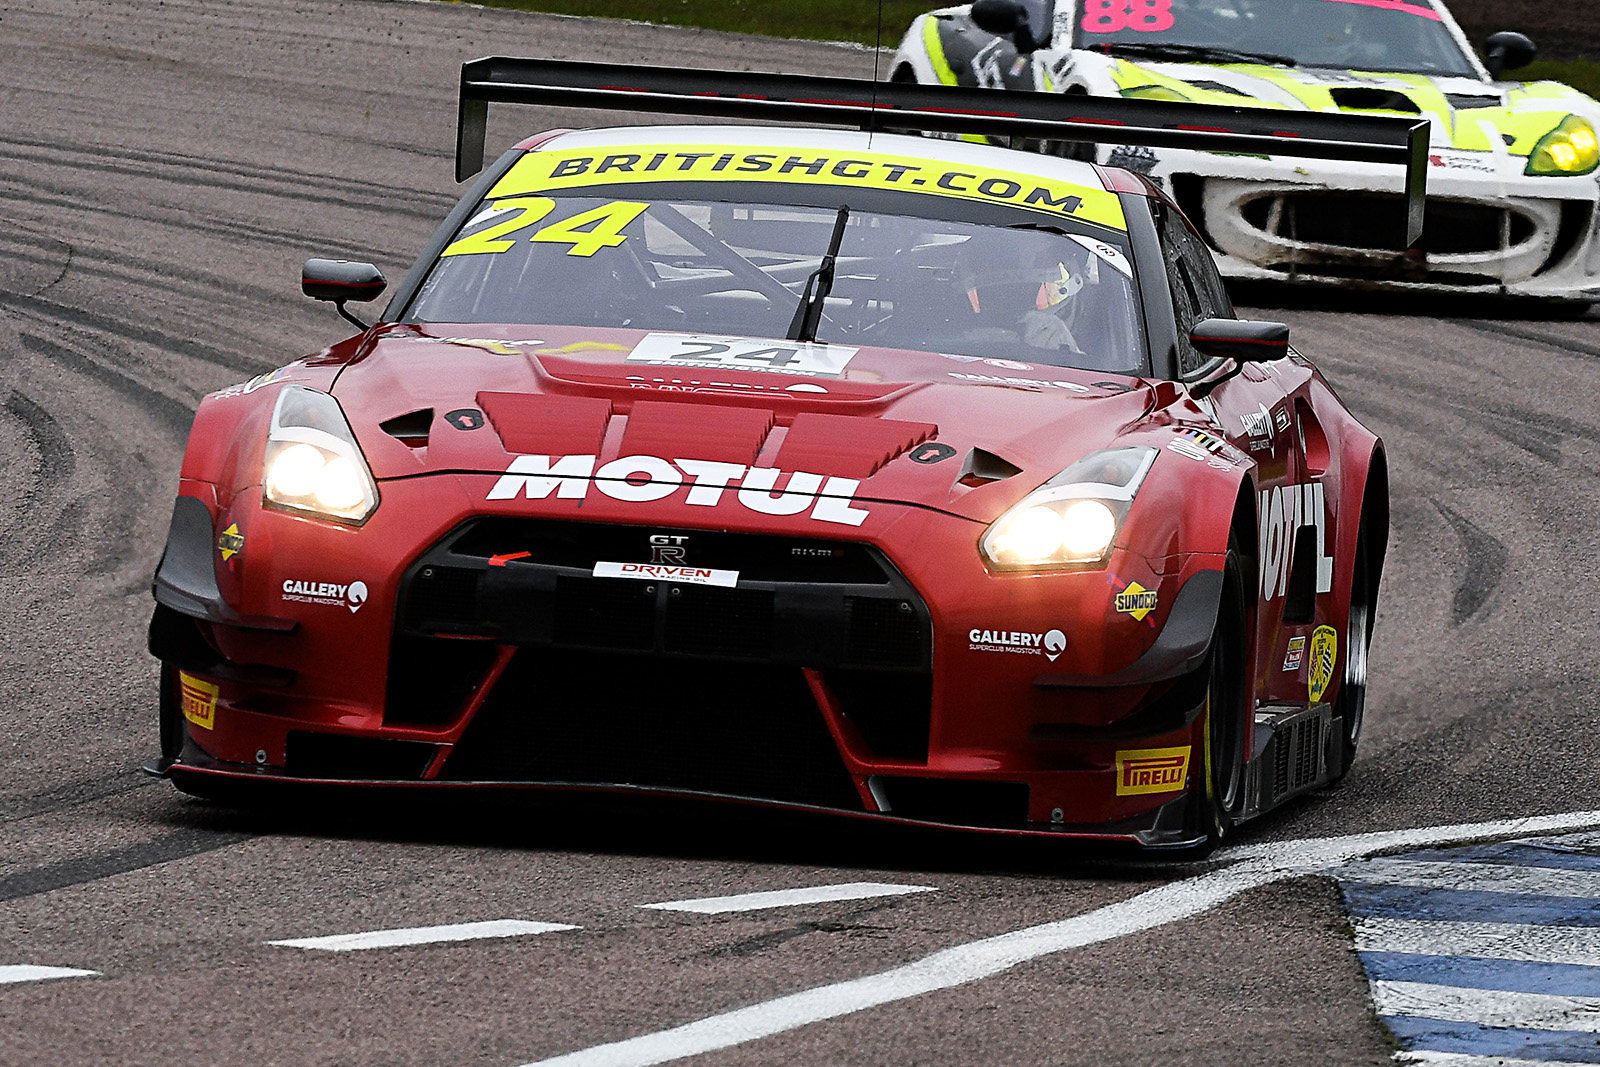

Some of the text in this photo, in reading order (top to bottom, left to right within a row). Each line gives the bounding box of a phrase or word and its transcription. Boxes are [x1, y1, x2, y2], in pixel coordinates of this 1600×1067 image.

[1081, 0, 1175, 33] 88
[550, 153, 1083, 214] BRITISHGT.COM
[440, 197, 651, 257] 24
[670, 341, 801, 367] 24
[485, 454, 870, 526] MOTUL
[649, 534, 690, 545] GT
[650, 545, 688, 565] R
[621, 564, 712, 577] DRIVEN
[283, 579, 347, 598] GALLERY
[1118, 593, 1156, 610] SUNOCO
[969, 629, 1043, 647] GALLERY
[969, 644, 1042, 655] SUPERCLUB MAIDSTONE
[1123, 755, 1185, 787] PIRELLI
